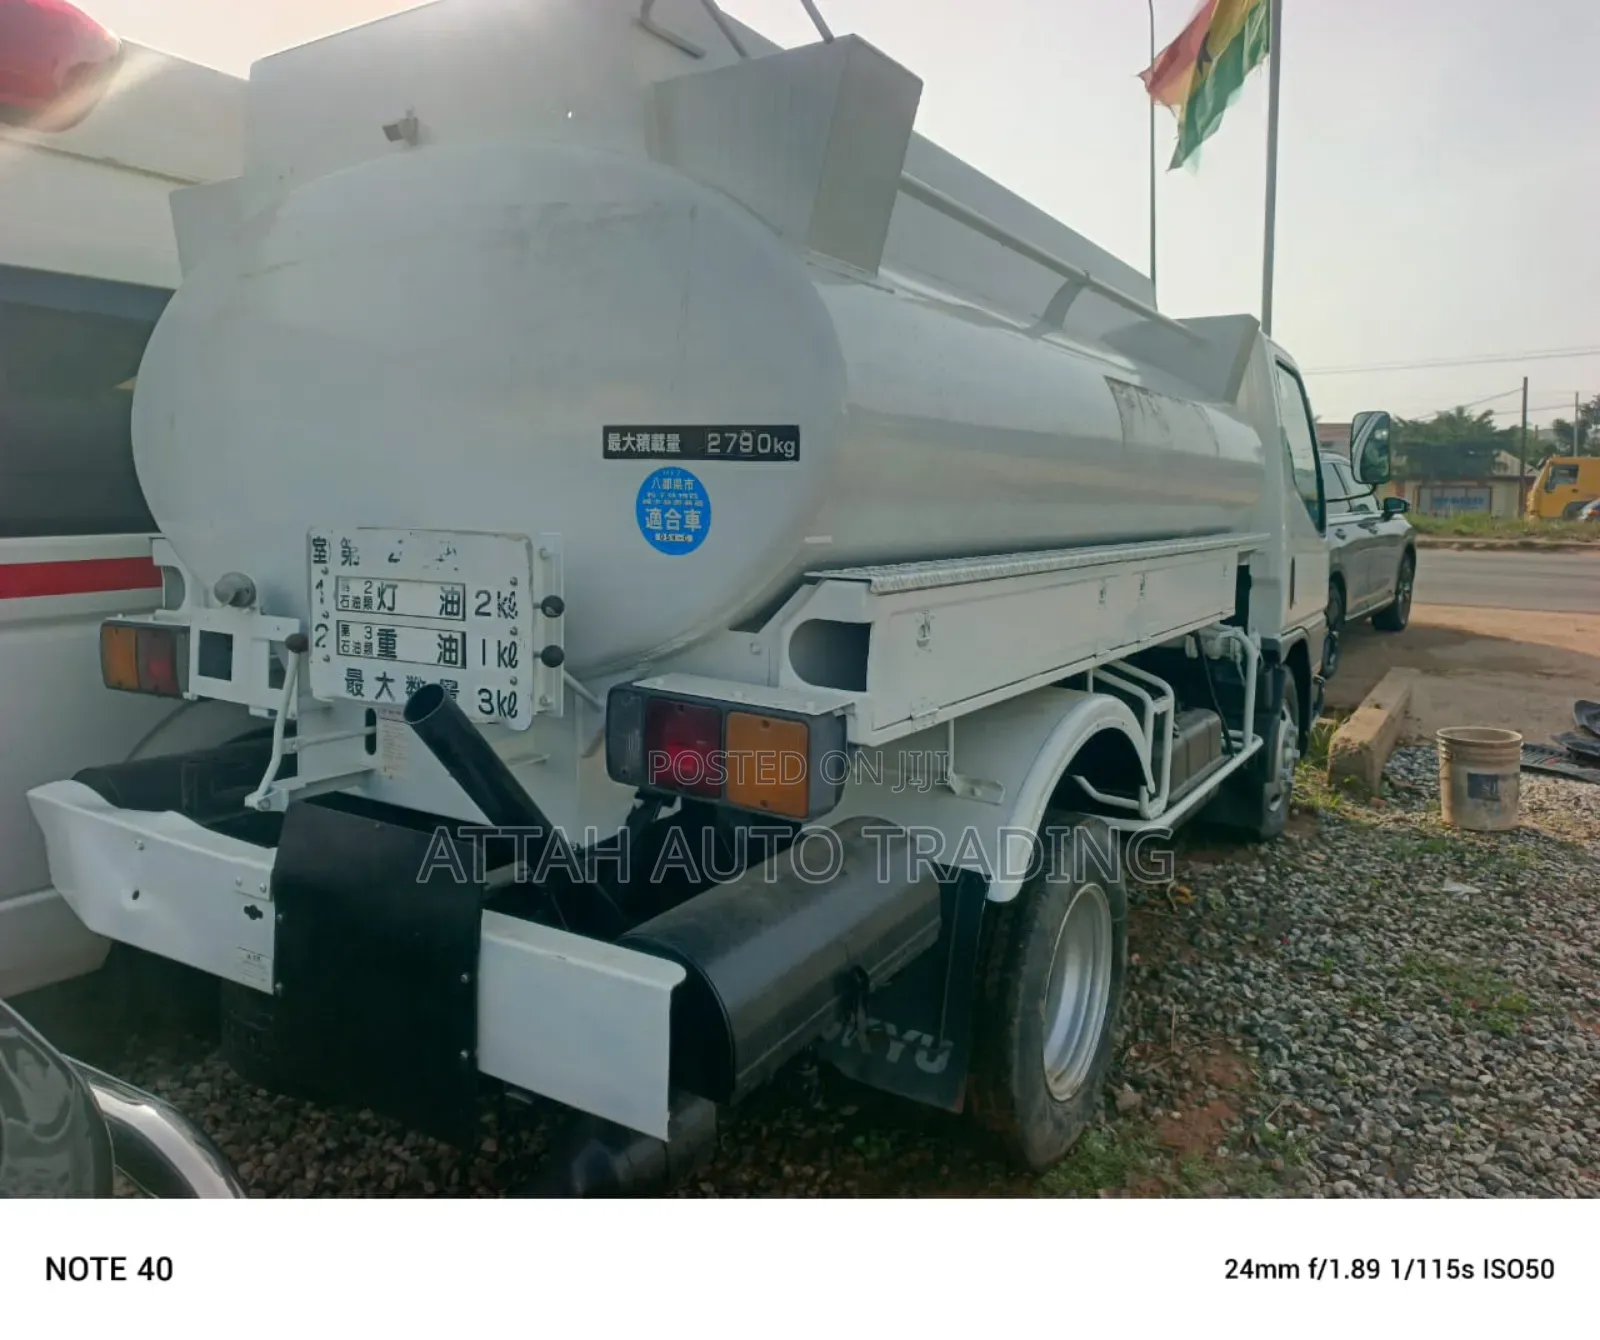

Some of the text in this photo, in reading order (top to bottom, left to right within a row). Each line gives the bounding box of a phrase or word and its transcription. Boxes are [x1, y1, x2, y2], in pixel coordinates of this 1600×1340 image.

[607, 432, 681, 452] 最大積載量
[645, 507, 702, 532] 適合車
[314, 623, 330, 648] 2
